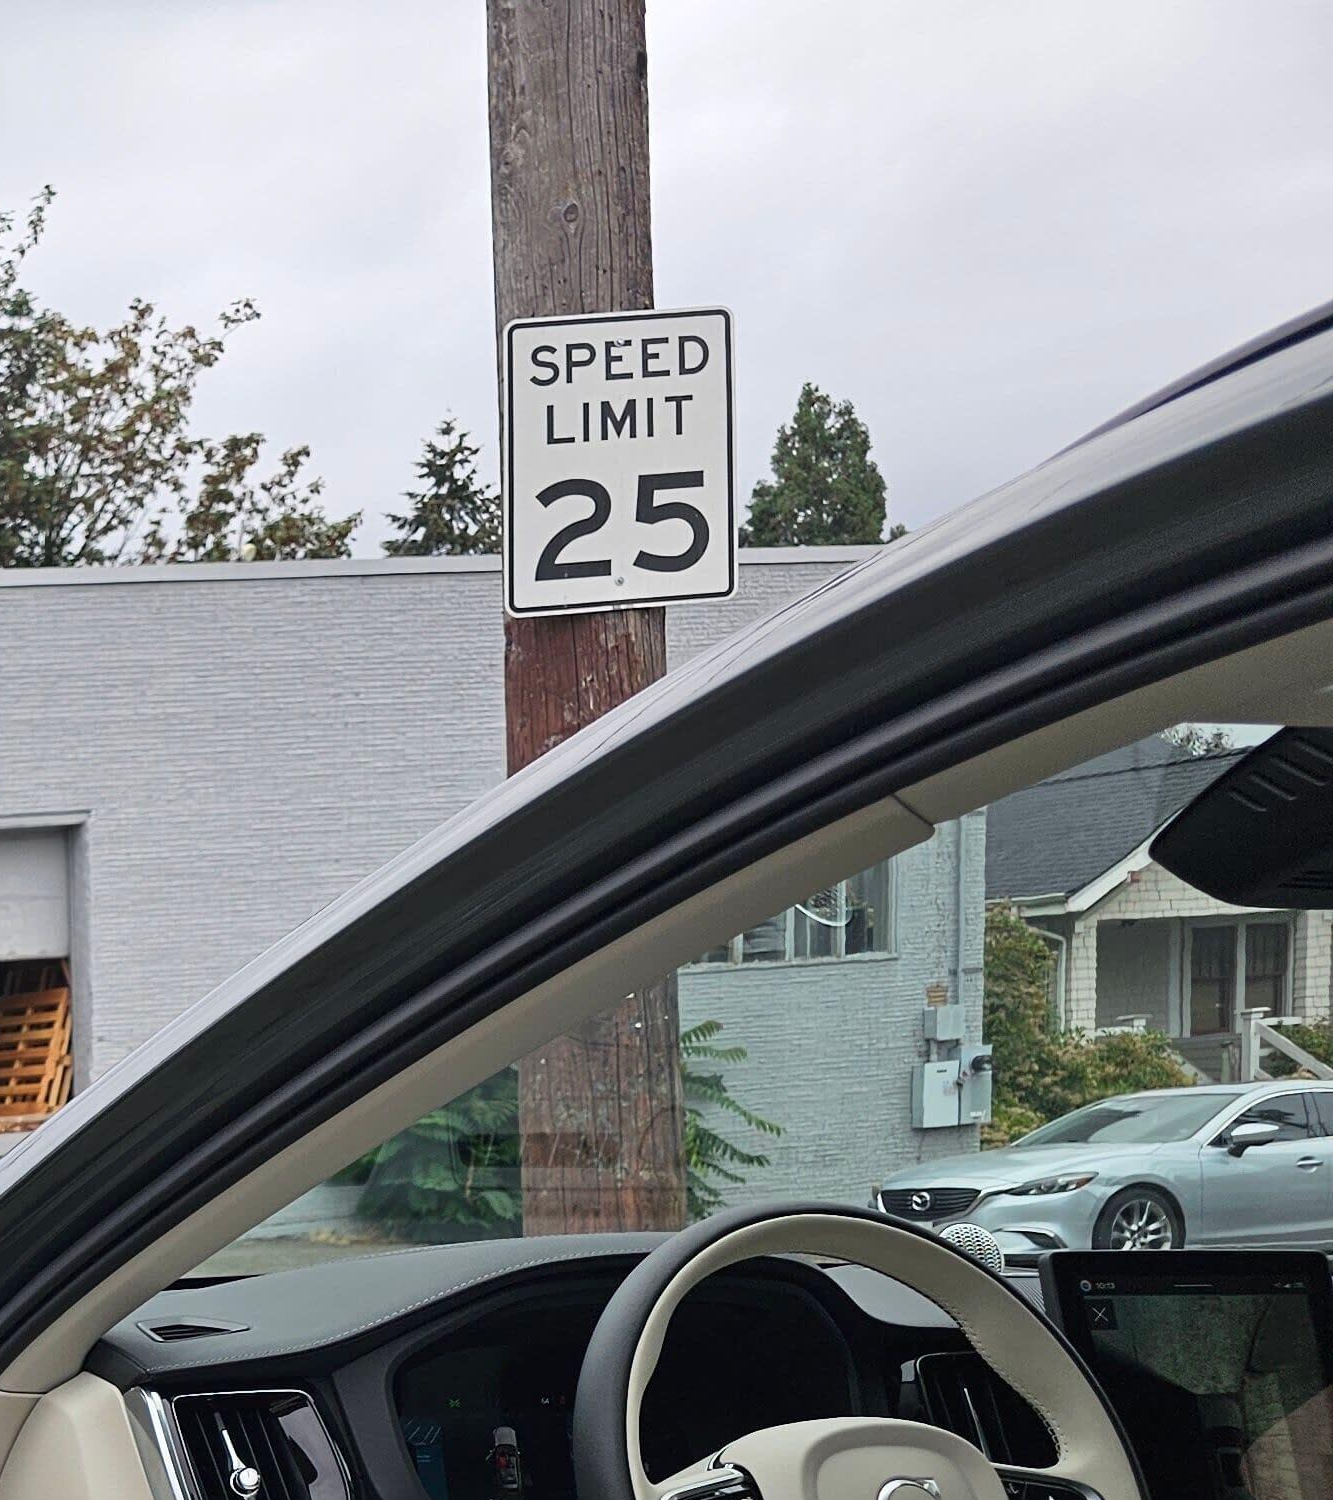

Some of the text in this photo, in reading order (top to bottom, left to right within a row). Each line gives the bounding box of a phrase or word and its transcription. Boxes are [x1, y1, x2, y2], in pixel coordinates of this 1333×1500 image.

[530, 336, 710, 386] SPEED
[546, 395, 693, 444] LIMIT
[535, 470, 710, 582] 25
